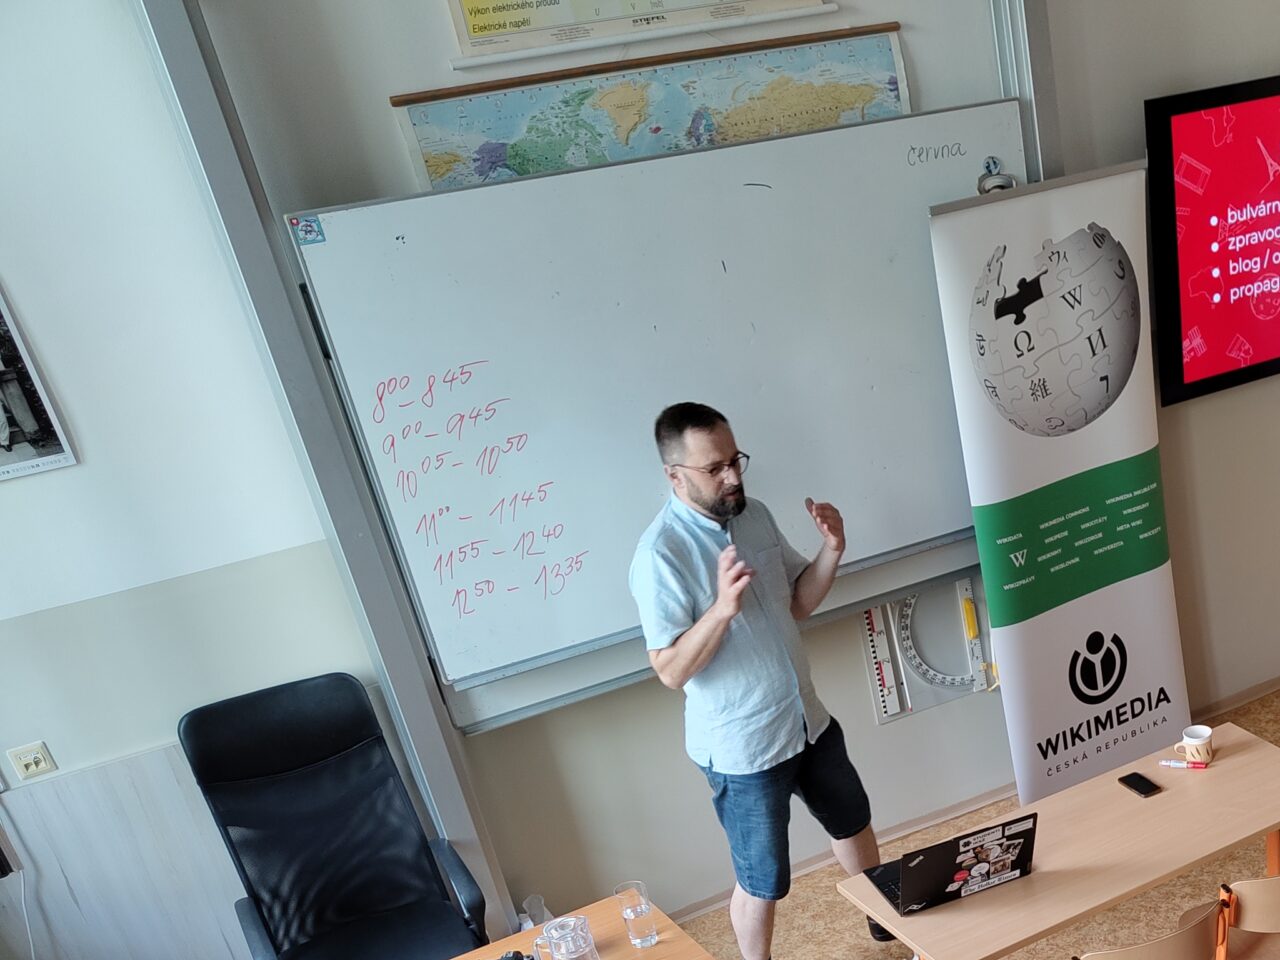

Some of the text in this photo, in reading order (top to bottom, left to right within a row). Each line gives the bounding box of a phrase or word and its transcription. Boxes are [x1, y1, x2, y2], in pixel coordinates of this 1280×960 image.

[468, 7, 490, 18] Výkon
[491, 1, 534, 14] elektrického
[472, 18, 531, 34] Elektrické napětí
[632, 15, 667, 25] STIEFEL
[907, 142, 967, 167] června
[1229, 256, 1261, 276] blog
[1009, 549, 1028, 568] W
[1036, 686, 1171, 761] WIKIMEDIA
[1047, 716, 1168, 777] ČESKÁ REPUBLIKA
